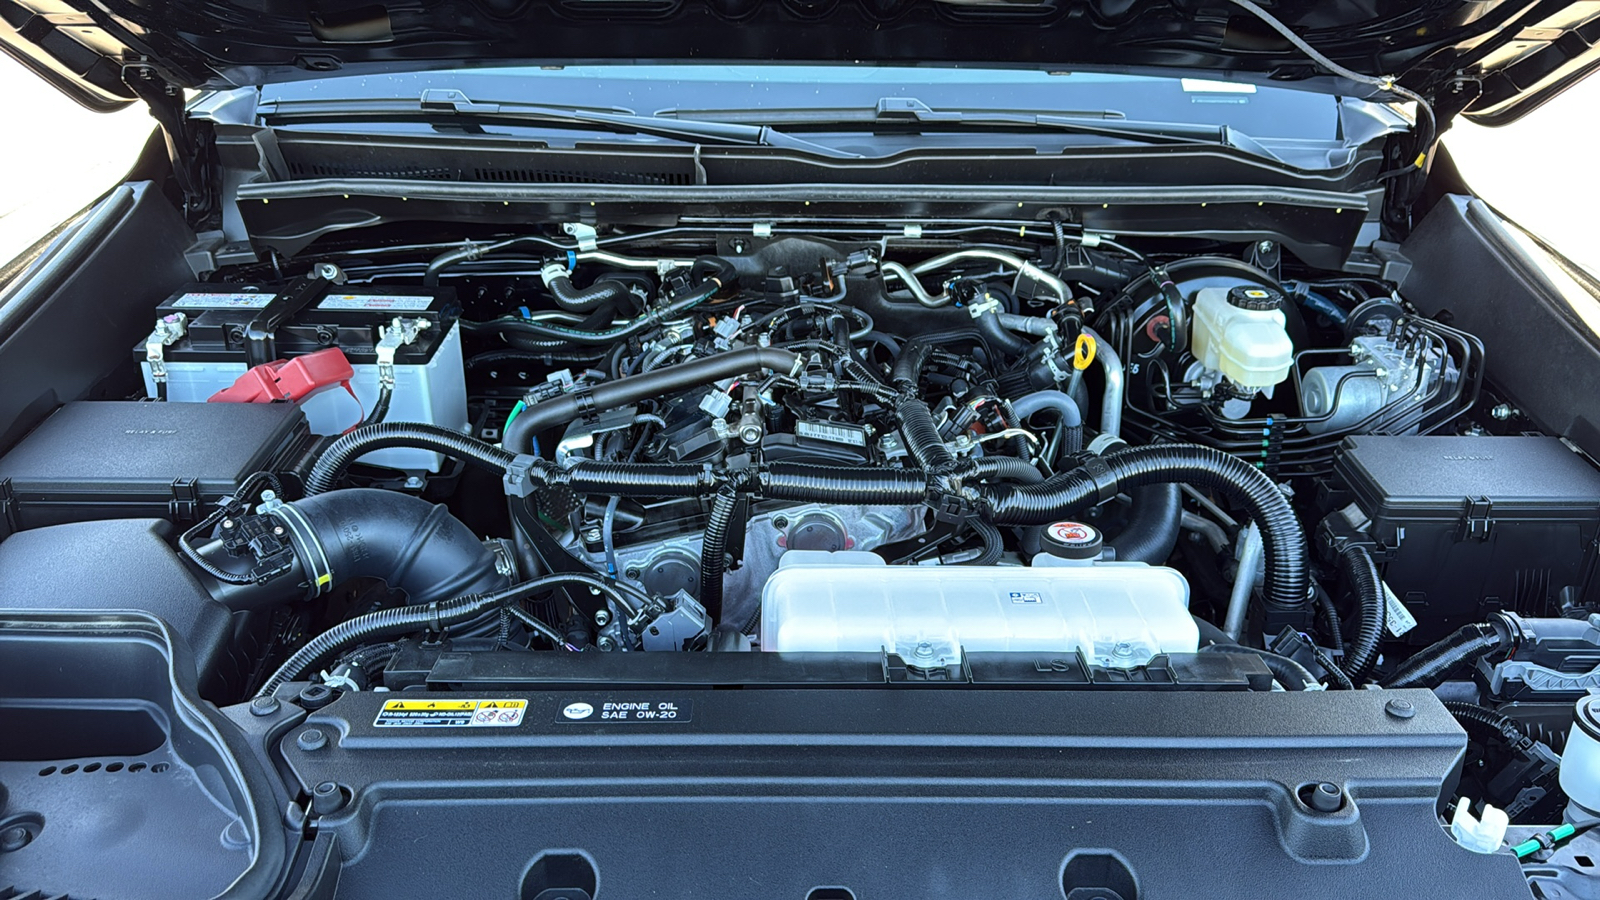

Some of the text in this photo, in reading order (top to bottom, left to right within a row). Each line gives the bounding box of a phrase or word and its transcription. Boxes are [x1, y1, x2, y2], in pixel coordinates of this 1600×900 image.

[1033, 659, 1070, 672] LS
[603, 702, 679, 710] ENGINE OIL
[601, 711, 677, 719] SAE 0W-20
